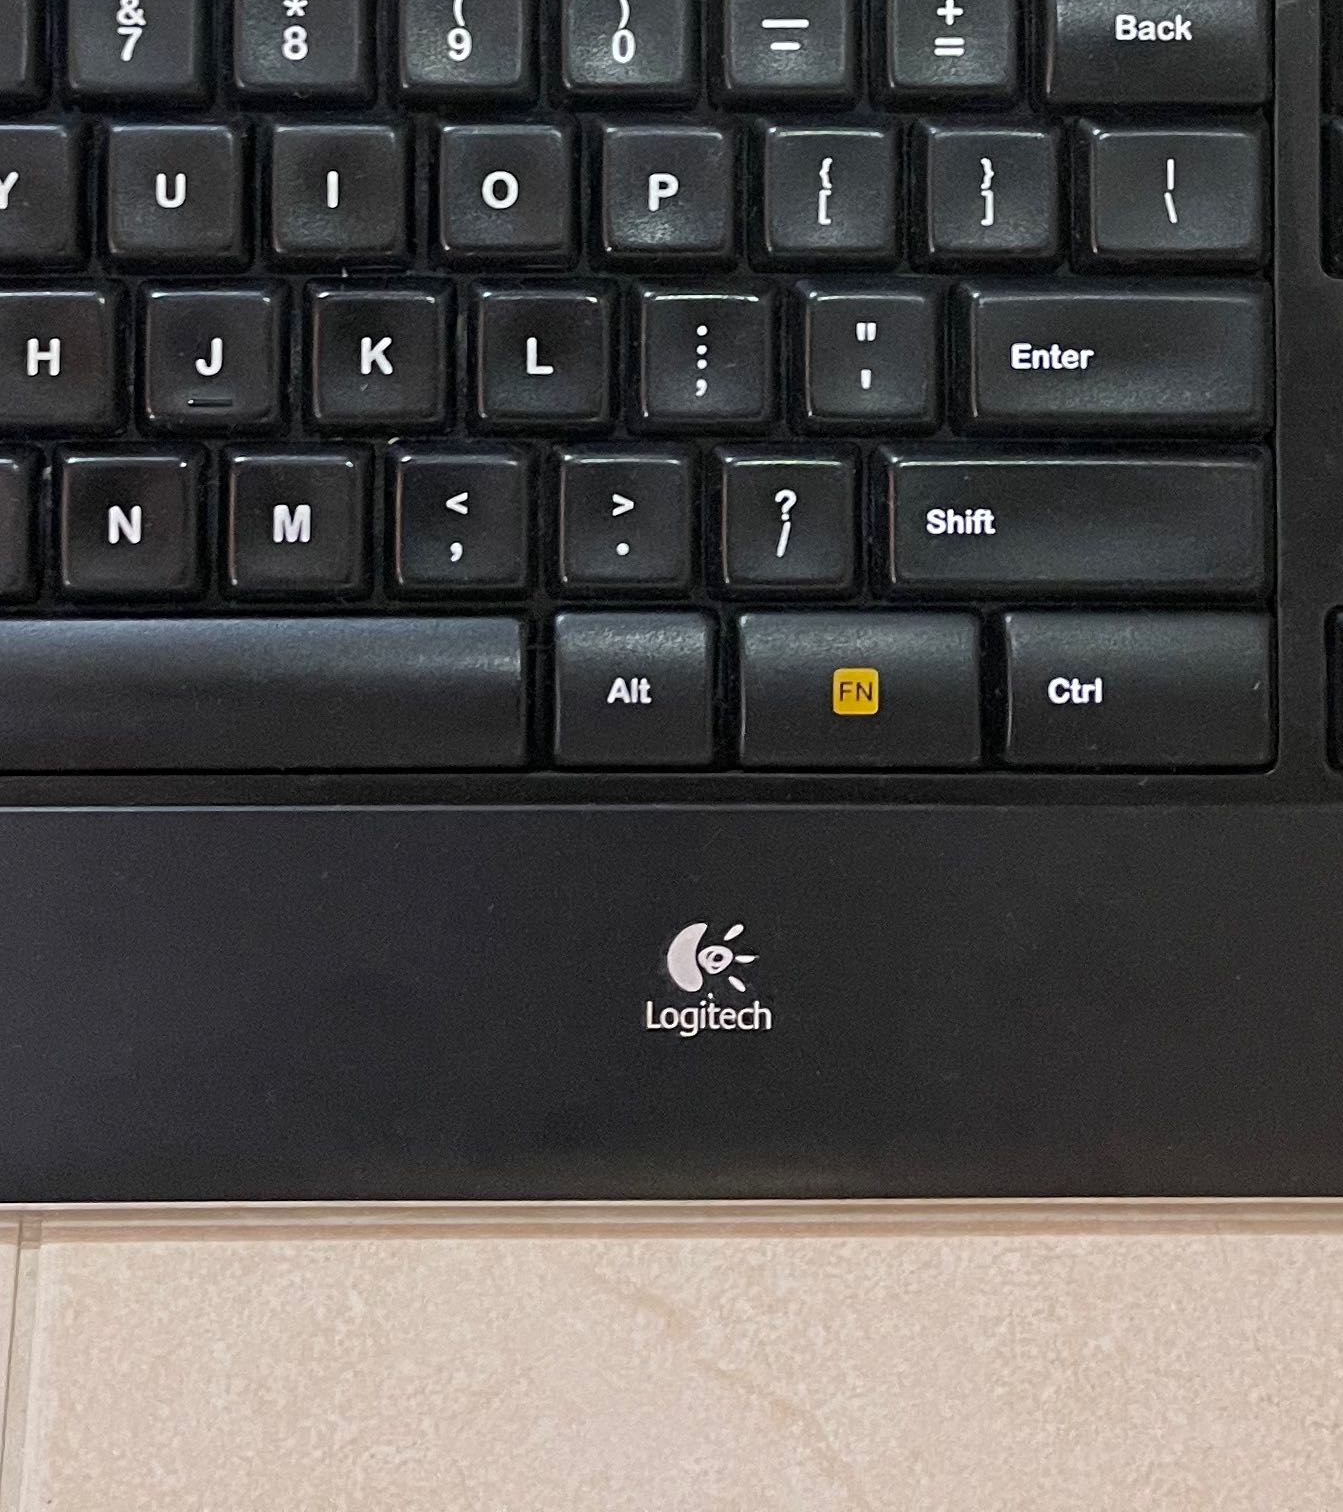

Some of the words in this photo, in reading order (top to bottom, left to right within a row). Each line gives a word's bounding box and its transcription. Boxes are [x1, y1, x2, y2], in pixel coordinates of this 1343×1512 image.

[117, 26, 143, 62] 7
[282, 25, 309, 61] 8
[447, 27, 472, 62] 9
[1115, 13, 1193, 41] Back
[611, 29, 636, 64] 0
[933, 37, 965, 57] =
[155, 173, 186, 208] U
[326, 170, 339, 209] I
[481, 171, 519, 209] O
[818, 157, 833, 190] {
[980, 157, 995, 190] }
[648, 173, 679, 212] P
[818, 189, 832, 226] [
[980, 189, 994, 226] ]
[26, 338, 61, 376] H
[195, 337, 223, 376] J
[360, 336, 393, 375] K
[526, 337, 554, 375] L
[1011, 342, 1095, 370] Enter
[445, 492, 468, 515] <
[612, 493, 635, 517] >
[774, 489, 797, 521] ?
[108, 505, 142, 544] N
[273, 504, 311, 543] M
[926, 508, 996, 535] Shift
[776, 521, 791, 558] /
[606, 677, 652, 704] Alt
[839, 681, 873, 702] FN
[1047, 676, 1103, 704] Ctrl
[645, 999, 773, 1038] Logitech
